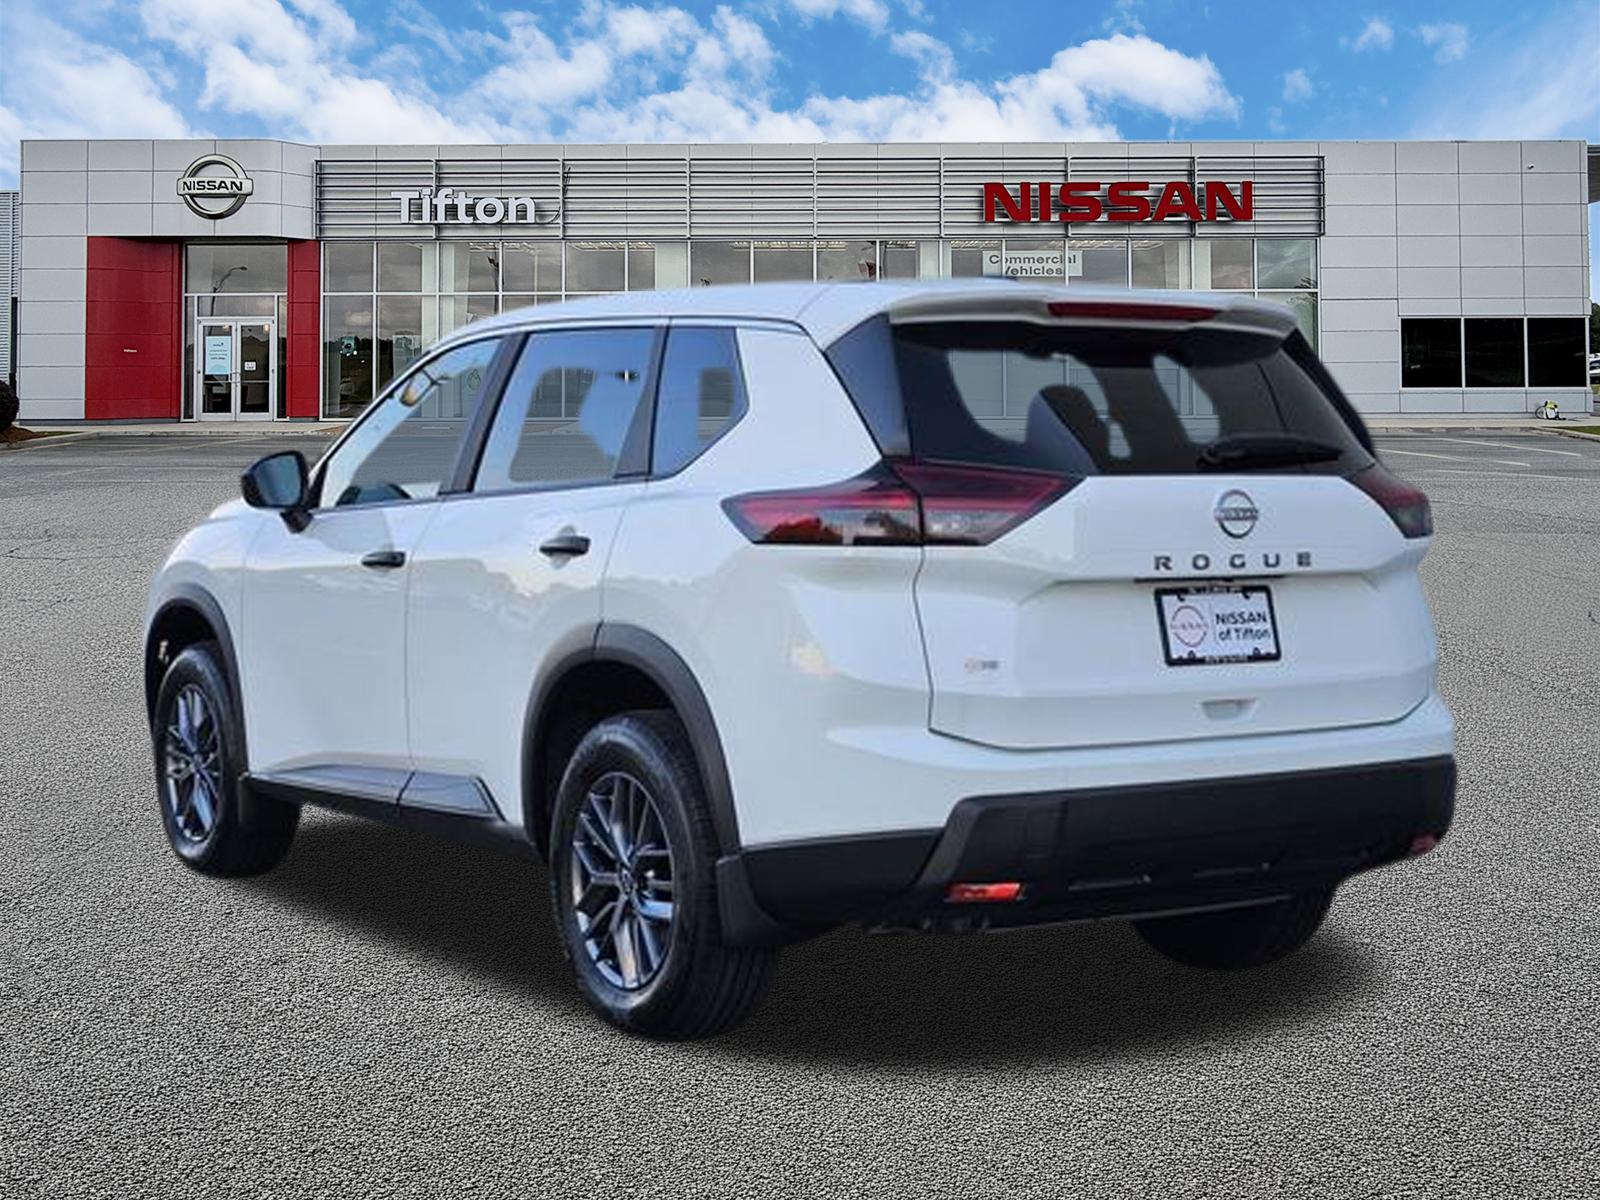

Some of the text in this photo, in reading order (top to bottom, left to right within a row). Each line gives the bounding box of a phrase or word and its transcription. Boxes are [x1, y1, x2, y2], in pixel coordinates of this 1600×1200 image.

[183, 180, 243, 191] NISSAN
[391, 188, 536, 224] Tifton
[984, 181, 1253, 222] NISSAN
[1154, 551, 1312, 572] ROGUE
[1215, 611, 1268, 625] NISSAN
[1218, 628, 1231, 641] of
